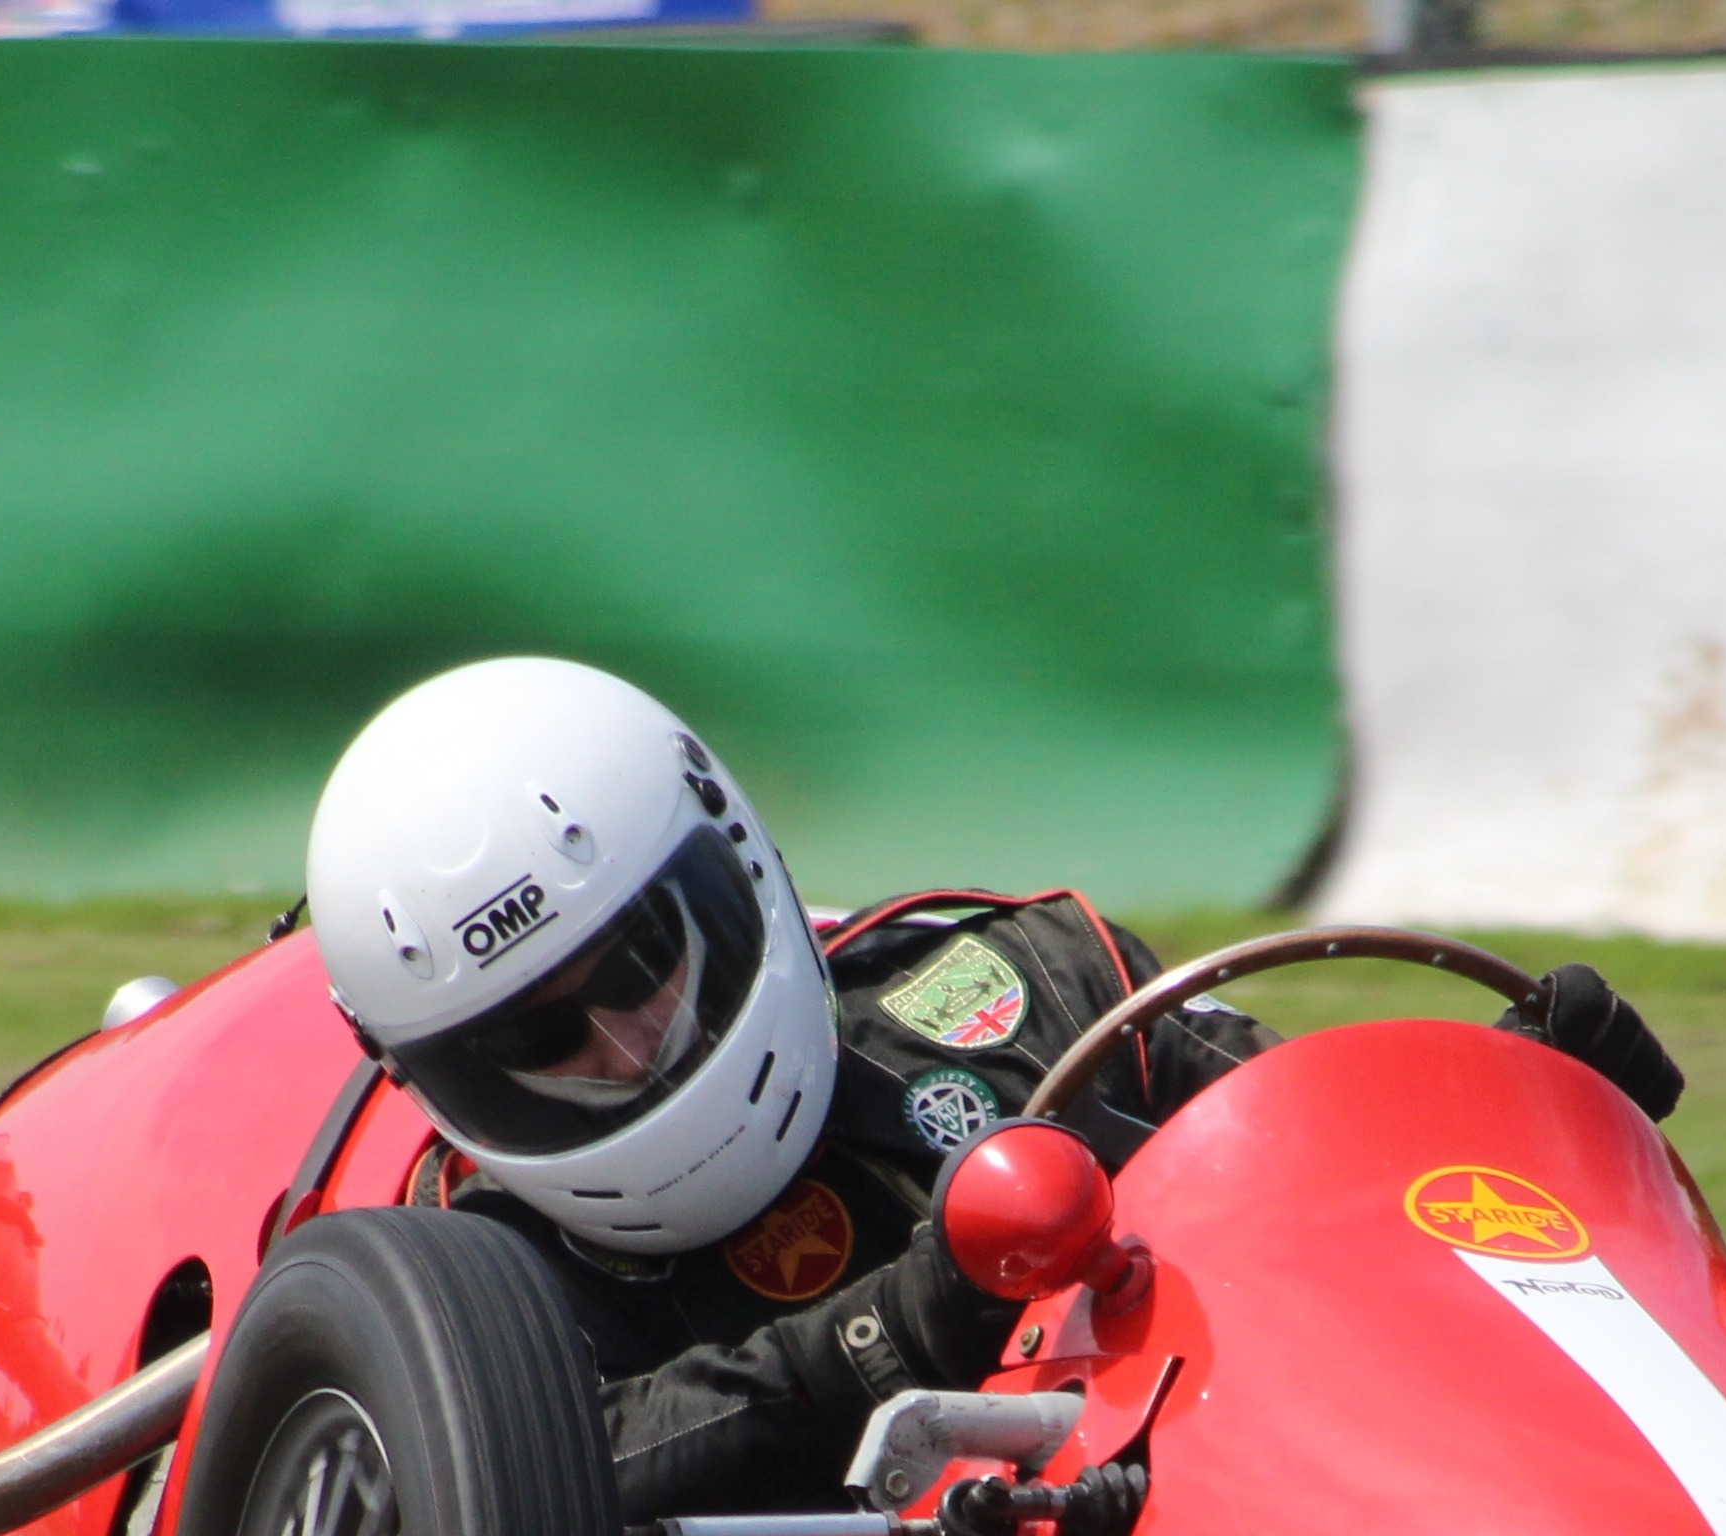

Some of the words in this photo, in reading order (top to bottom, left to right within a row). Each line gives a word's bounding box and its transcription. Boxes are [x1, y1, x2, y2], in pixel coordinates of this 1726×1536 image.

[462, 884, 545, 957] OMP
[929, 1101, 960, 1131] 750
[1428, 1204, 1570, 1232] STARIDE
[739, 1199, 835, 1275] STARIDE
[1501, 1277, 1625, 1301] Norton
